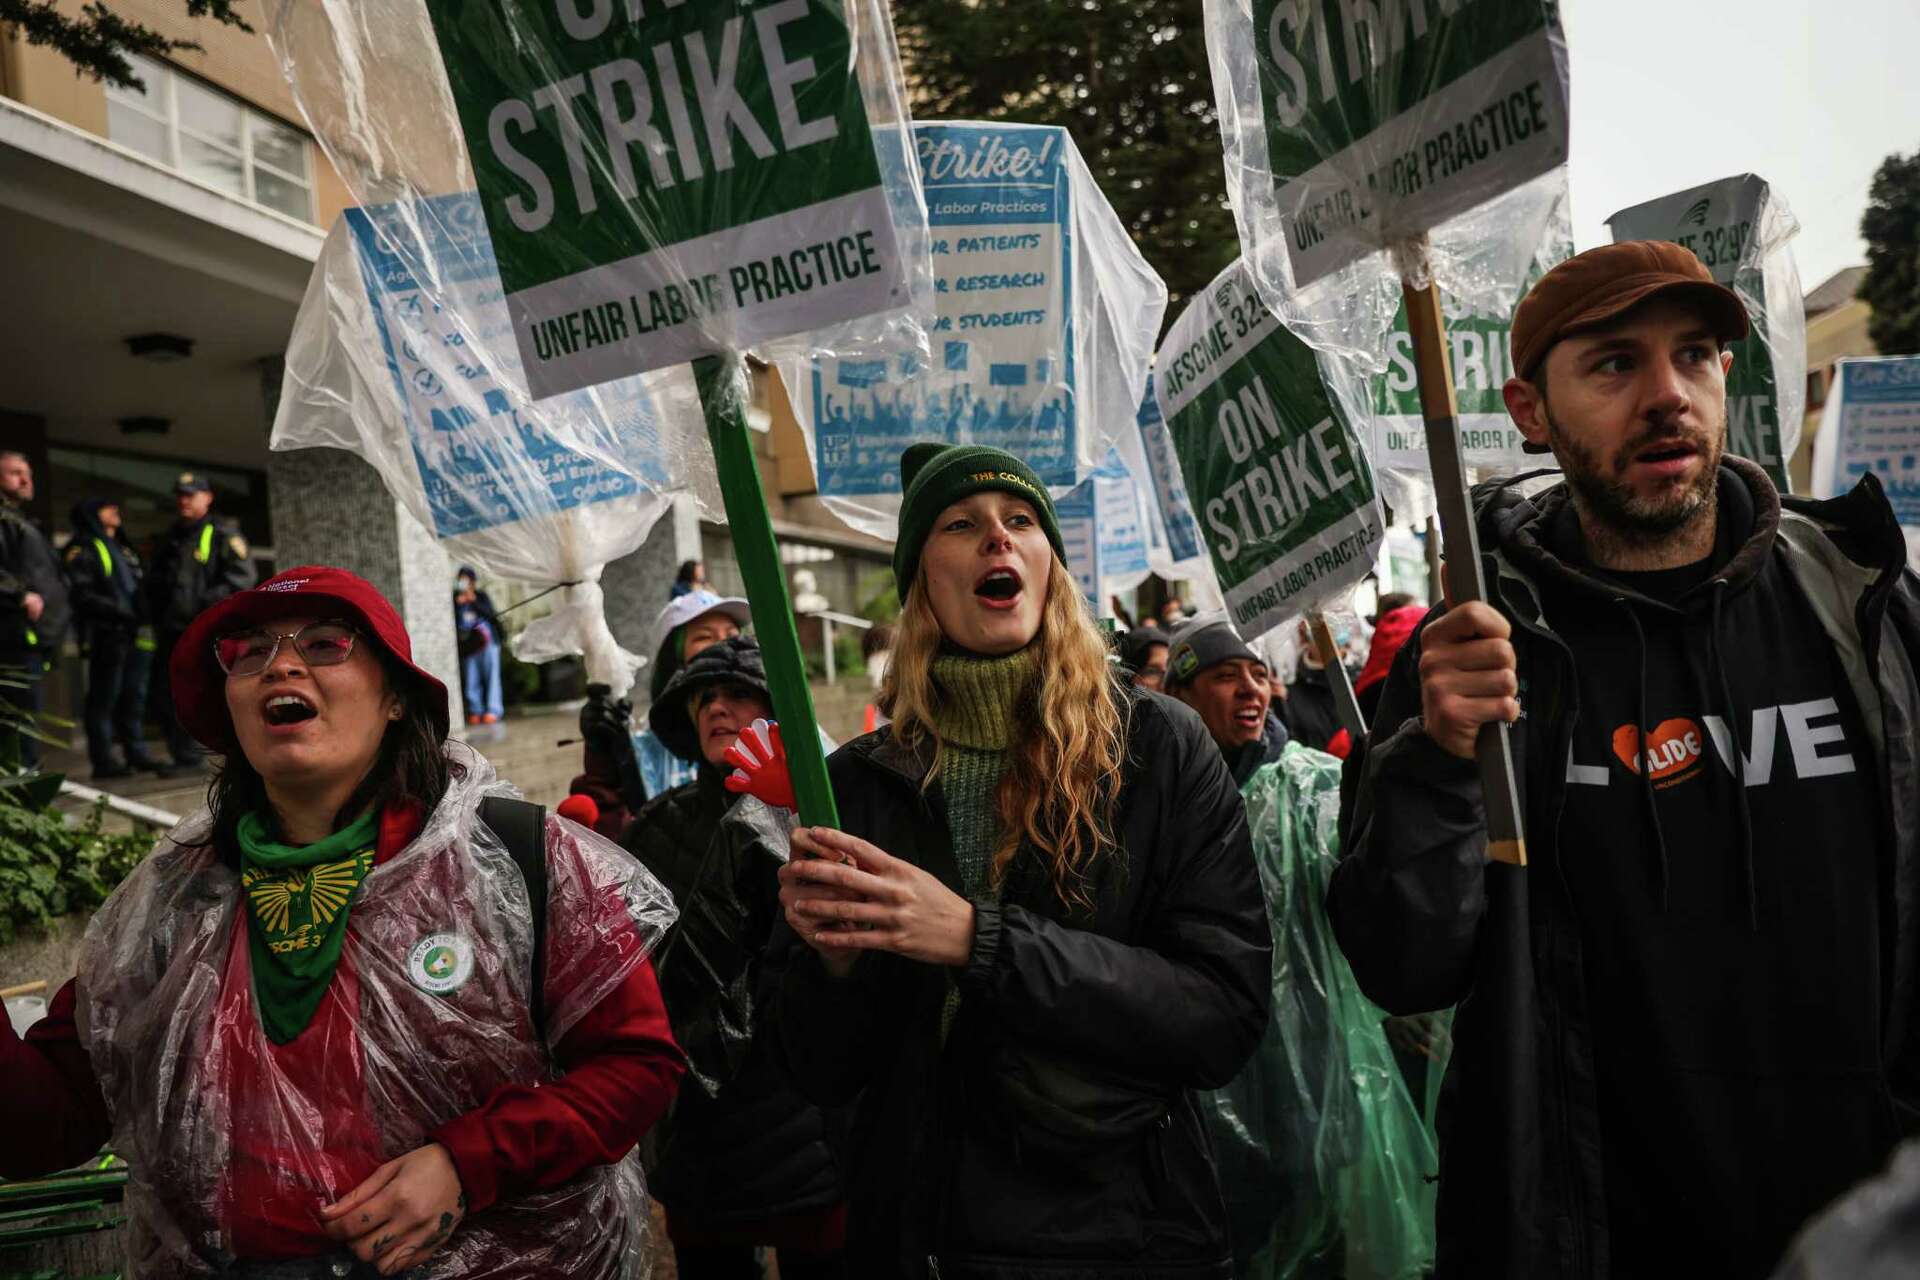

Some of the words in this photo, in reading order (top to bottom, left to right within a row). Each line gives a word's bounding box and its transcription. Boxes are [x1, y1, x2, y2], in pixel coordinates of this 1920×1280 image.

[487, 4, 839, 233] STRIKE
[1425, 81, 1549, 184] PRACTICE
[935, 202, 976, 215] Labor
[980, 200, 1047, 213] Practices
[957, 234, 1041, 253] PATIENTS
[531, 303, 629, 362] UNFAIR
[729, 231, 881, 308] PRACTICE
[955, 272, 1045, 291] RESEARCH
[959, 310, 1046, 328] STUDENTS
[1165, 321, 1233, 400] AFSCME
[1231, 290, 1272, 338] 32
[1217, 374, 1281, 464] ON
[1460, 430, 1504, 450] ABOR
[1205, 416, 1354, 562] STRIKE
[1234, 586, 1279, 625] UNFAIR
[1274, 562, 1317, 601] LABOR
